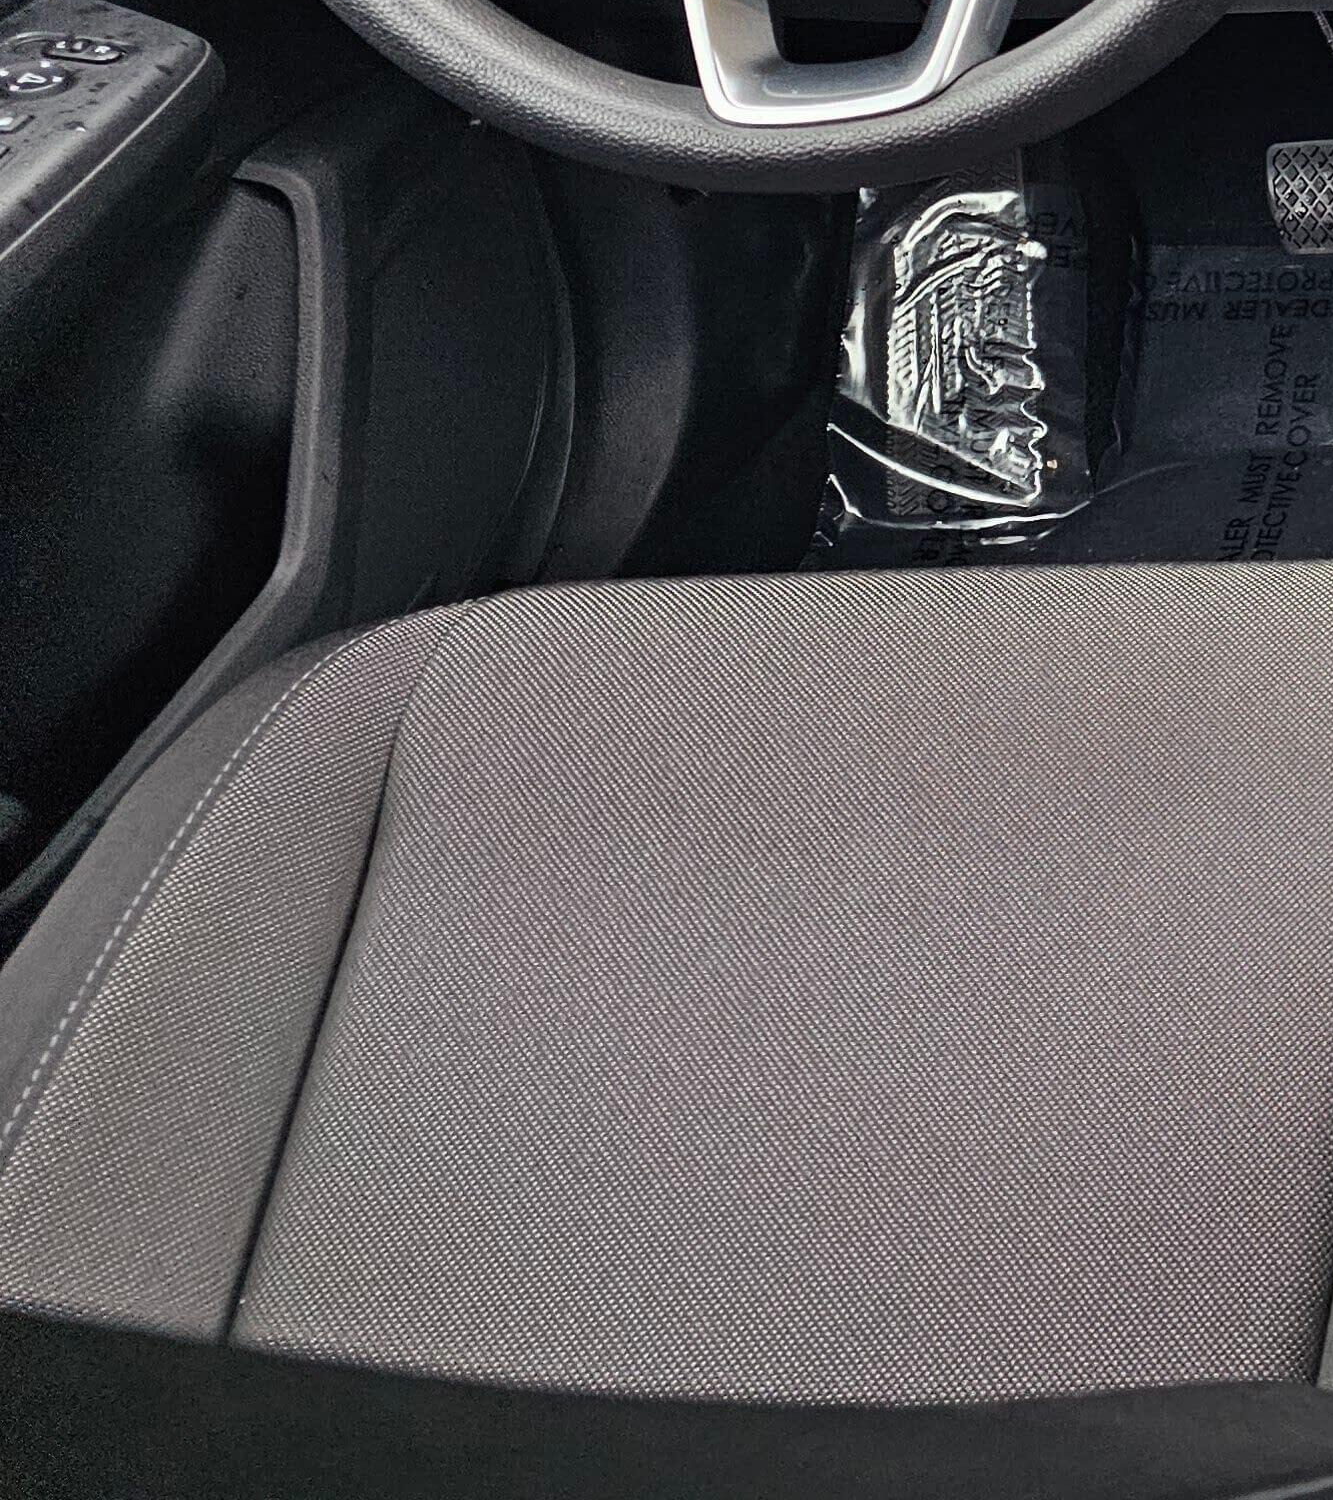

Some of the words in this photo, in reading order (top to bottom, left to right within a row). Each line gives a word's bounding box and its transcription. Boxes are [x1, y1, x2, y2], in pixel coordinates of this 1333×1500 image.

[1224, 299, 1332, 321] DEALER
[1237, 452, 1273, 504] MUST
[1255, 322, 1297, 438] REMOVE
[1283, 372, 1322, 467] COVER
